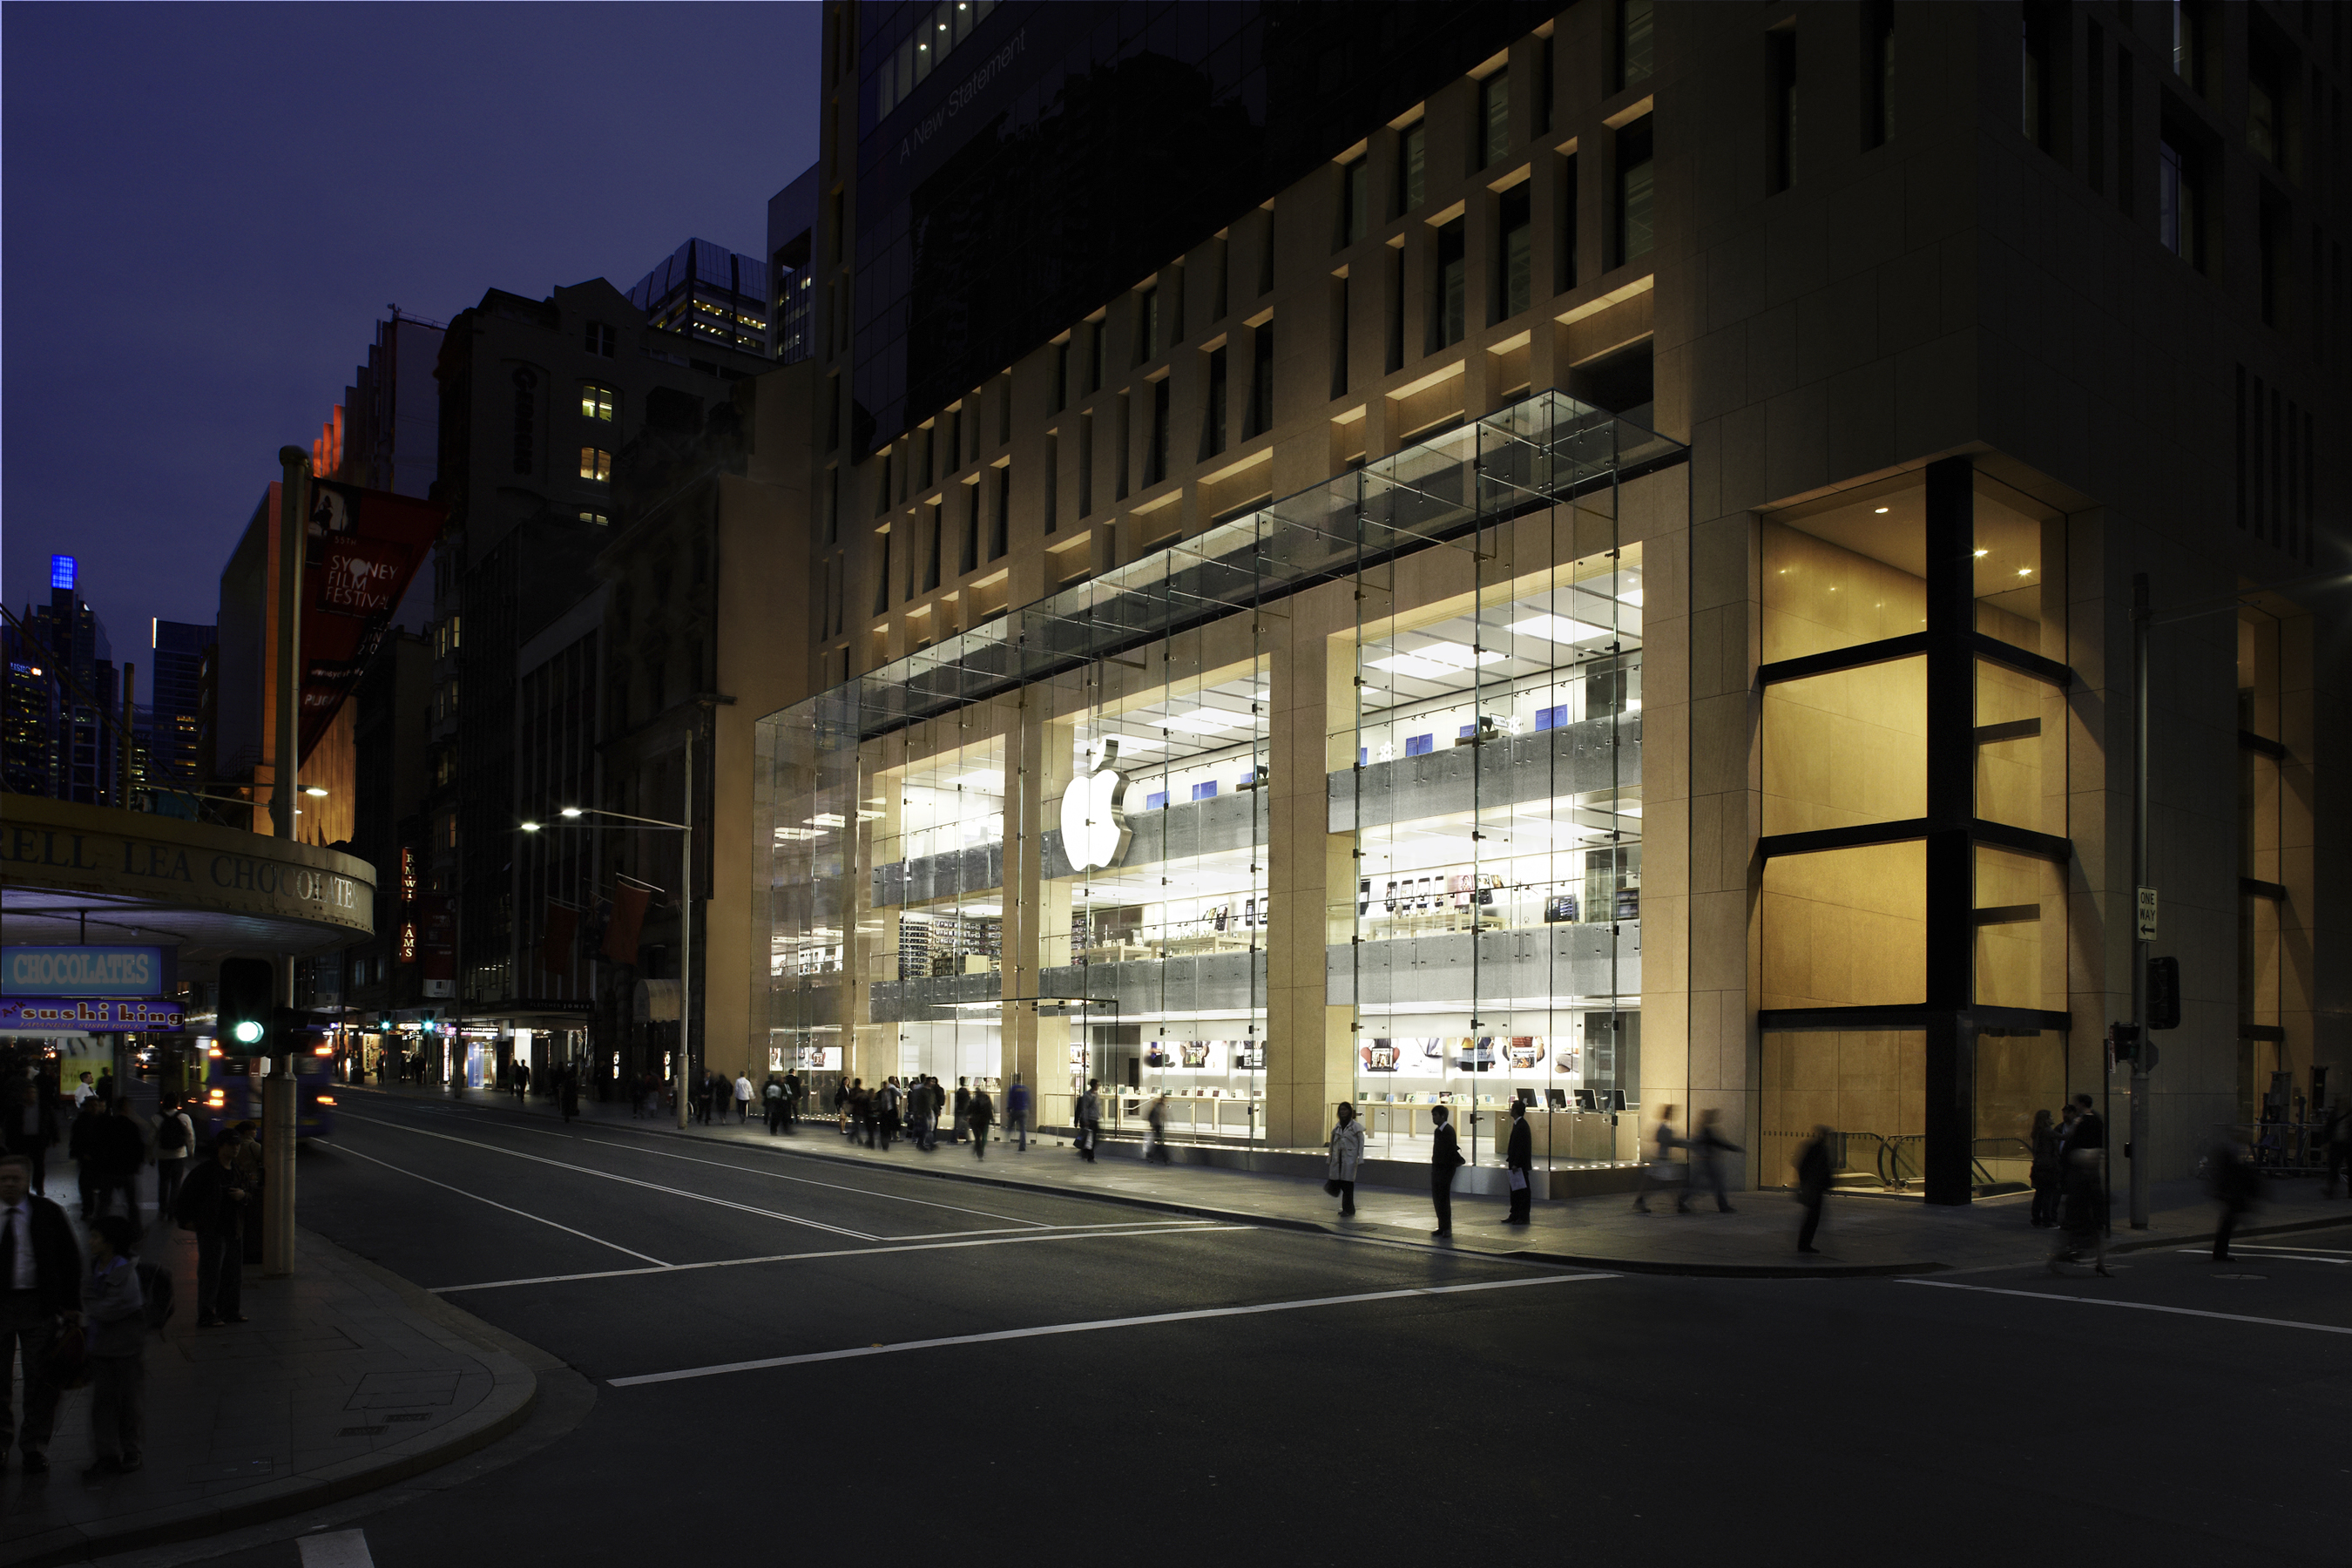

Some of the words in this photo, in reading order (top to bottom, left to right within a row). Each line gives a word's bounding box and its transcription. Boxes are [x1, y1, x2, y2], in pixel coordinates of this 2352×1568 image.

[900, 137, 910, 165] A
[914, 107, 945, 151] New
[949, 27, 1025, 117] Statement
[328, 570, 368, 591] FILM
[326, 585, 389, 611] FESTIVAL
[0, 825, 98, 870] ELL
[122, 841, 194, 882] LEA
[2140, 891, 2154, 905] ONE
[2139, 908, 2156, 922] WAY
[13, 953, 149, 985] CHOCOLATES
[1, 1001, 26, 1018] Ark
[21, 1002, 109, 1022] sushi
[118, 1003, 185, 1026] king
